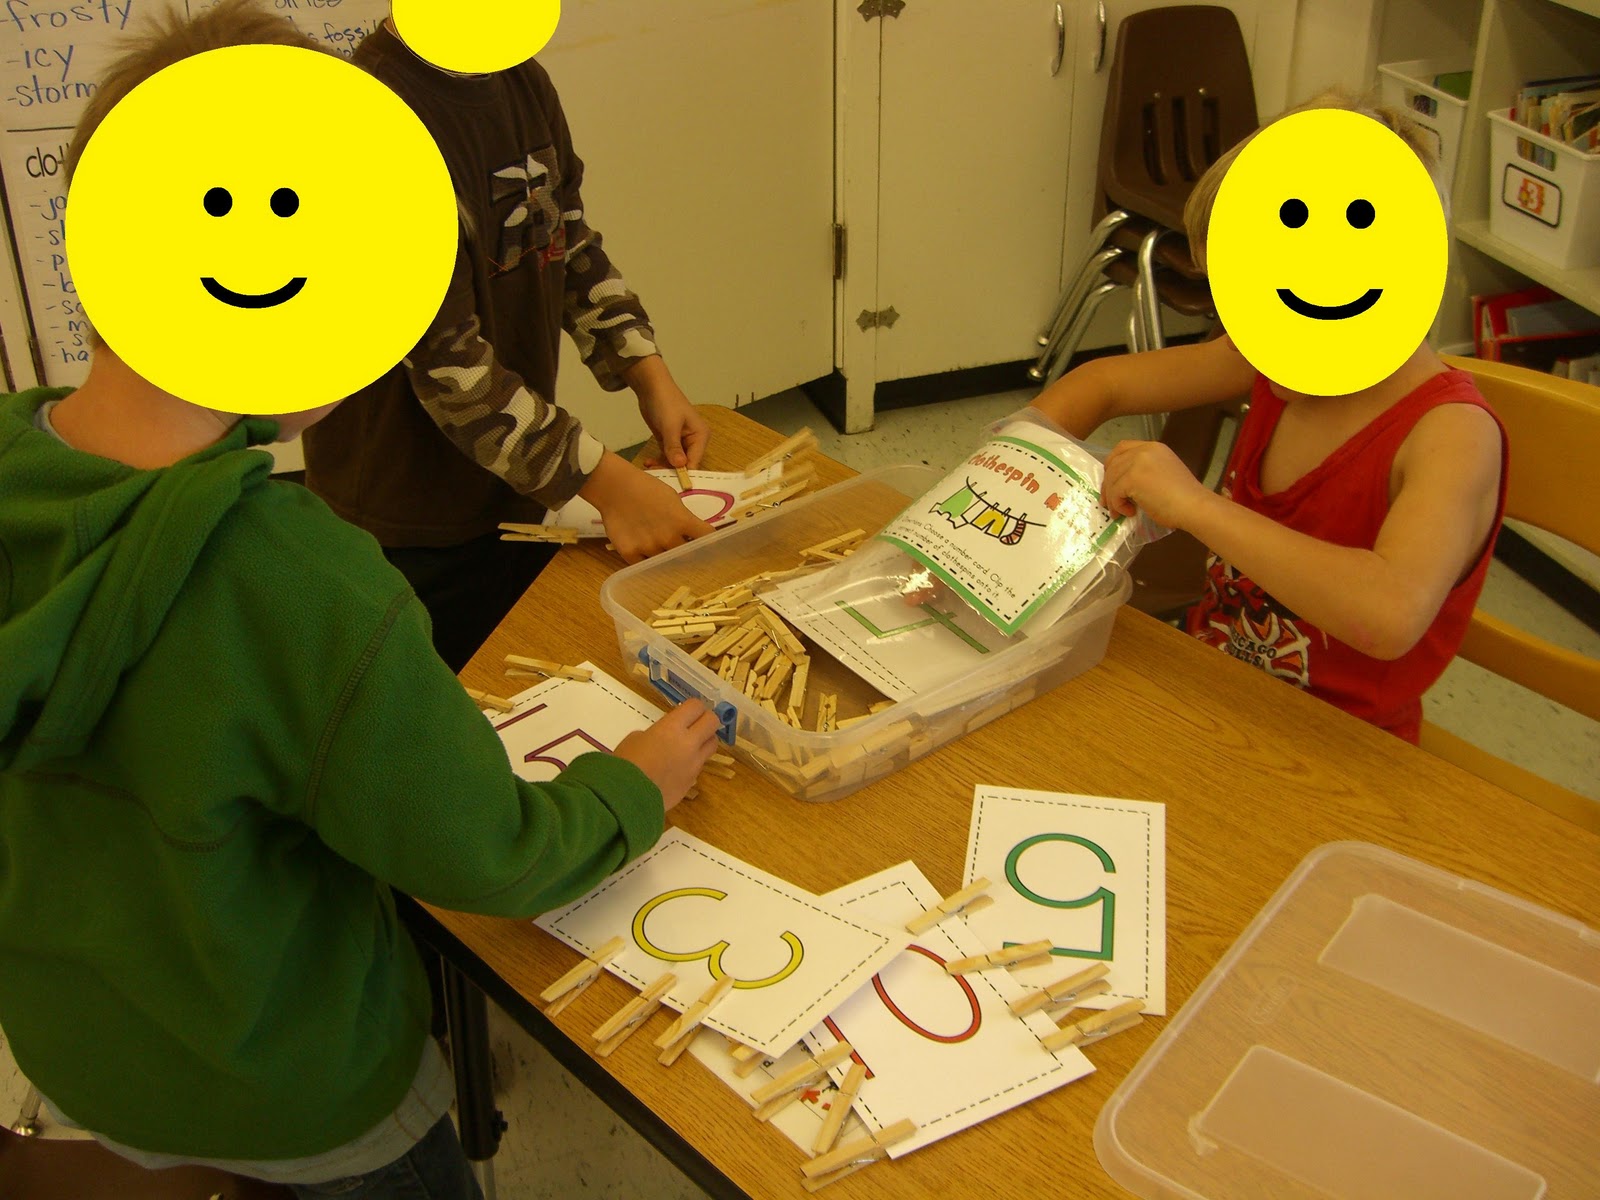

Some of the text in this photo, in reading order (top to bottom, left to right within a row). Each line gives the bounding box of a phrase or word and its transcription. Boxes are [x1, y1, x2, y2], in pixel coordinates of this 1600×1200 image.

[933, 544, 945, 552] of
[941, 550, 976, 580] clothespins
[976, 578, 992, 593] onto
[949, 542, 973, 561] number
[989, 573, 1003, 589] Clip
[1004, 586, 1016, 599] the
[1004, 832, 1117, 962] 5
[631, 887, 804, 990] 3
